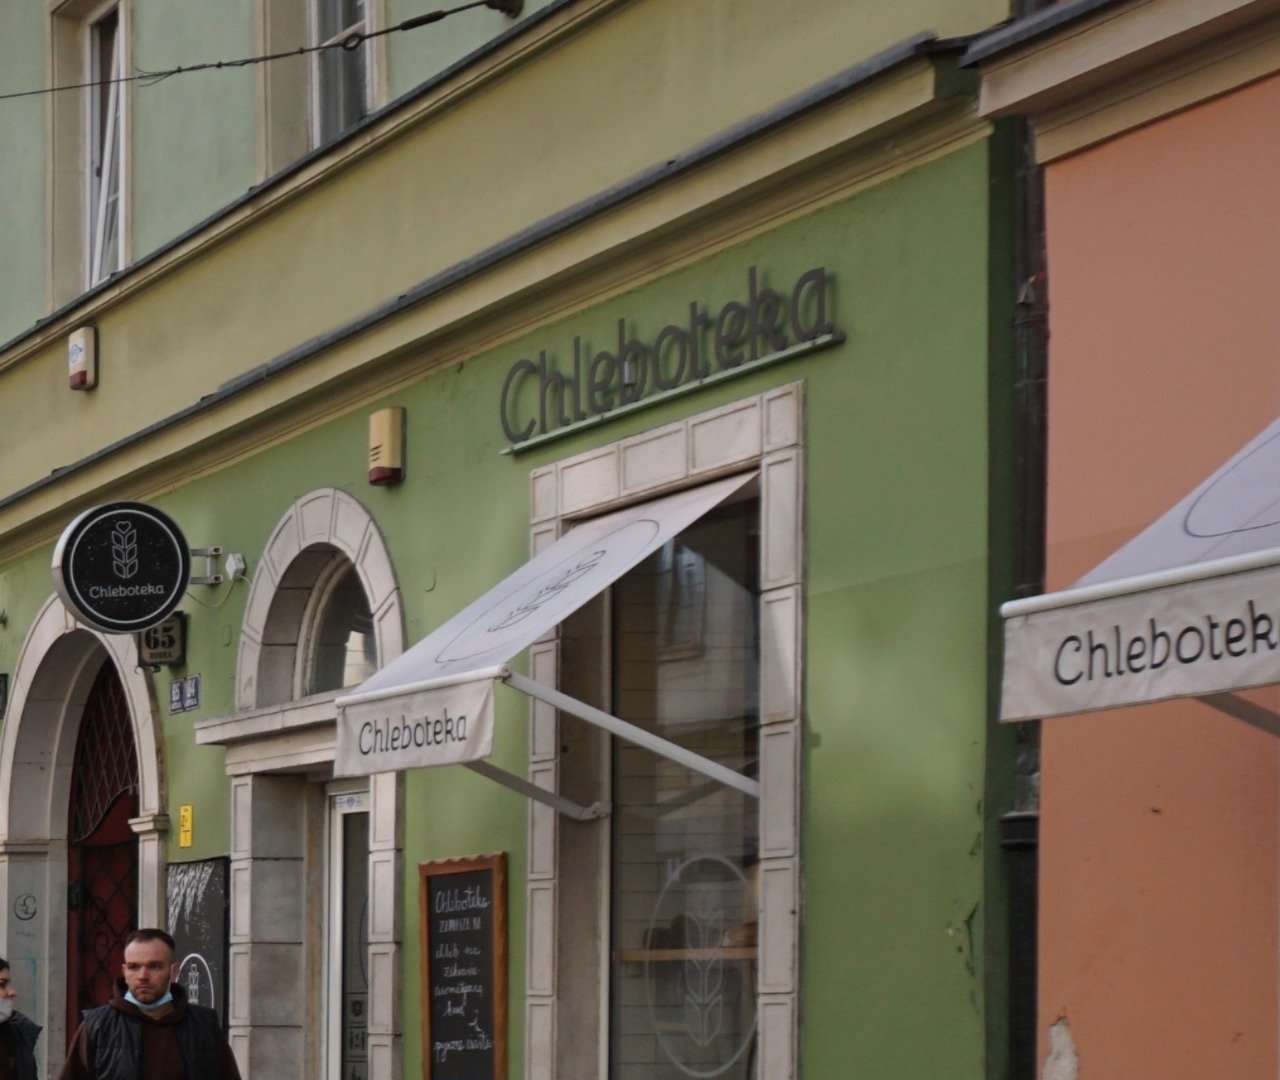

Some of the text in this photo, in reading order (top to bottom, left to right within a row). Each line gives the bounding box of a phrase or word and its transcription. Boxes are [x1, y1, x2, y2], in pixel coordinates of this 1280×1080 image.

[500, 265, 834, 442] Chleboteka
[89, 583, 166, 599] Chleboteka
[145, 626, 176, 650] 65
[1054, 600, 1280, 686] Chlebotek
[358, 707, 468, 756] Chleboteka
